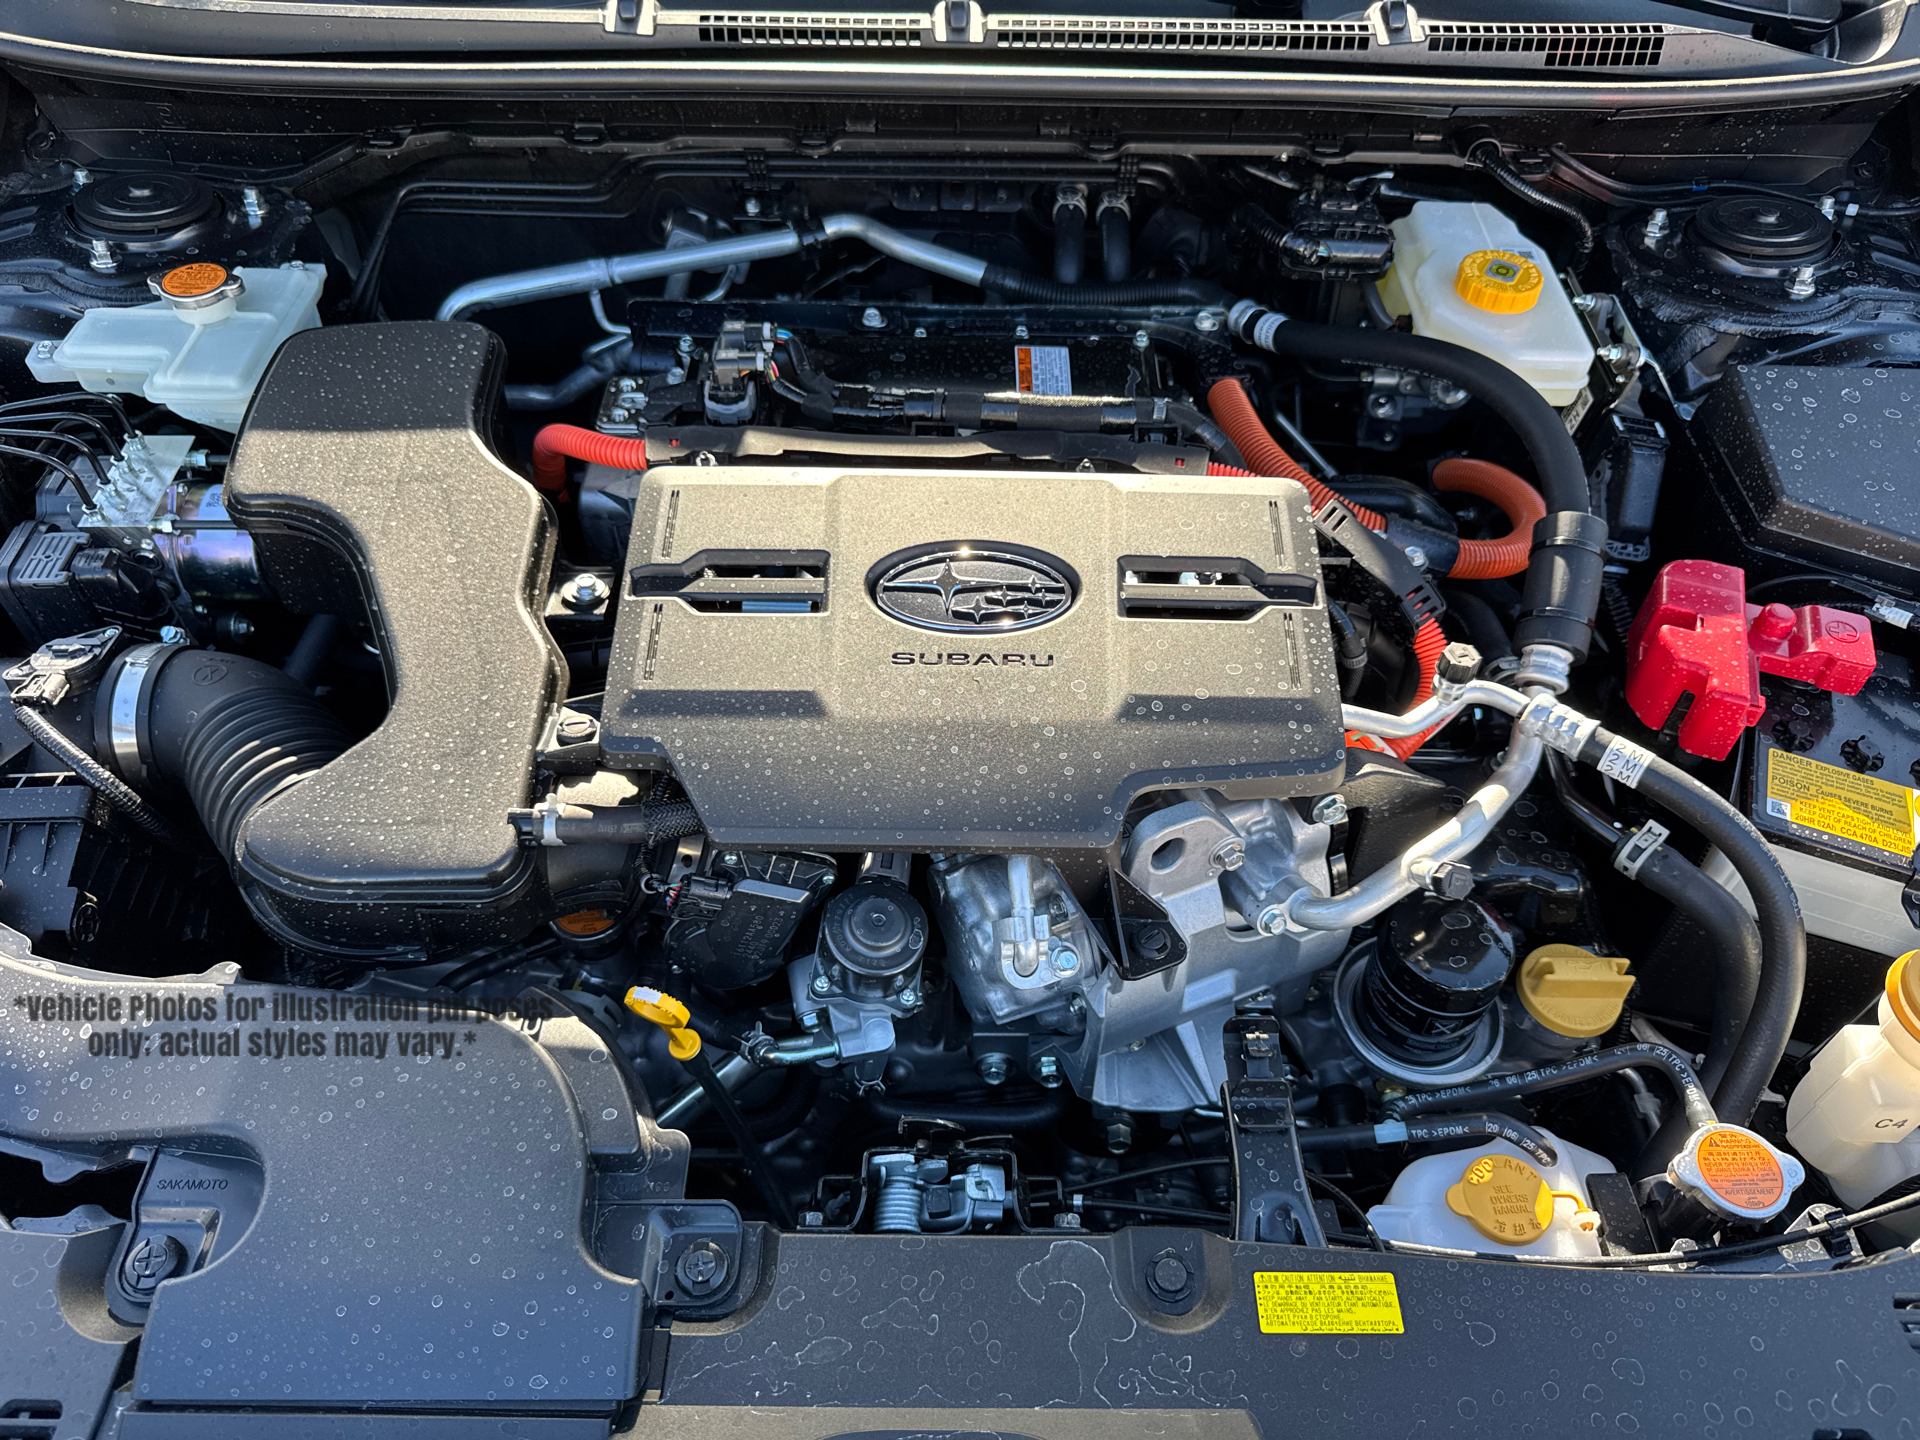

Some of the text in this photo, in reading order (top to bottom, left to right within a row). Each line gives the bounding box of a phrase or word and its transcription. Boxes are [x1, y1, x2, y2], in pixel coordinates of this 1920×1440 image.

[891, 652, 1054, 667] SUBARU
[1608, 753, 1638, 774] 2 M
[1772, 750, 1874, 786] DANGER EXPLOSIVE GASES
[1771, 774, 1809, 791] POISON
[1815, 787, 1842, 800] CAUSES
[1843, 796, 1869, 809] SEVERE
[1870, 804, 1893, 816] BURNS
[1799, 800, 1816, 810] KEEP
[1818, 805, 1835, 816] VENT
[1836, 811, 1854, 821] CAPS
[1855, 817, 1875, 828] TIGHT
[1799, 806, 1816, 817] KEEP
[1818, 811, 1831, 821] OUT
[1832, 816, 1841, 824] OF
[1843, 819, 1866, 831] REACH
[1867, 826, 1876, 834] OF
[1878, 829, 1911, 845] CHILDREN
[1794, 812, 1815, 825] 20HR
[1816, 819, 1836, 831] 62Ah
[1840, 826, 1858, 838] CCA
[1859, 831, 1878, 844] 470A
[1416, 1093, 1432, 1102] TPC
[1540, 1065, 1558, 1077] TPC
[1668, 1053, 1684, 1071] TPC
[1874, 1118, 1909, 1129] C4
[1411, 1129, 1429, 1138] TPC
[1535, 1148, 1551, 1163] TPC
[157, 1179, 229, 1190] SAKAMOTO
[1493, 1185, 1511, 1194] SEE
[1493, 1204, 1533, 1215] MANUAL
[1307, 1275, 1335, 1283] ATTENTION
